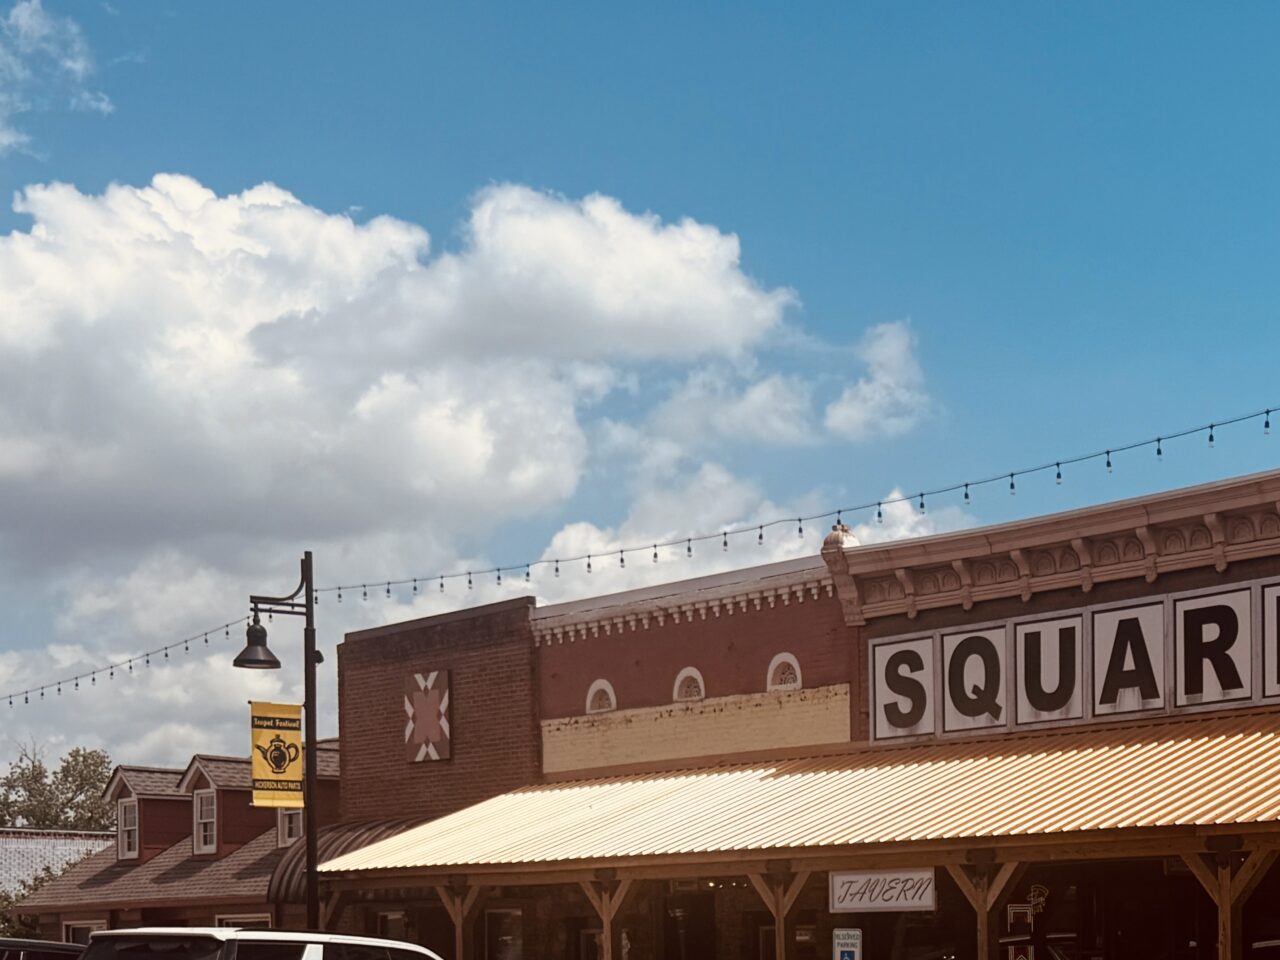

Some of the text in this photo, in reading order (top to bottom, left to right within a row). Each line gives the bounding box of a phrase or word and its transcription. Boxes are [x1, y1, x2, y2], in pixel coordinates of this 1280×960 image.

[275, 719, 300, 729] Festival
[837, 877, 933, 904] TAVERN
[836, 941, 859, 949] PARKING
